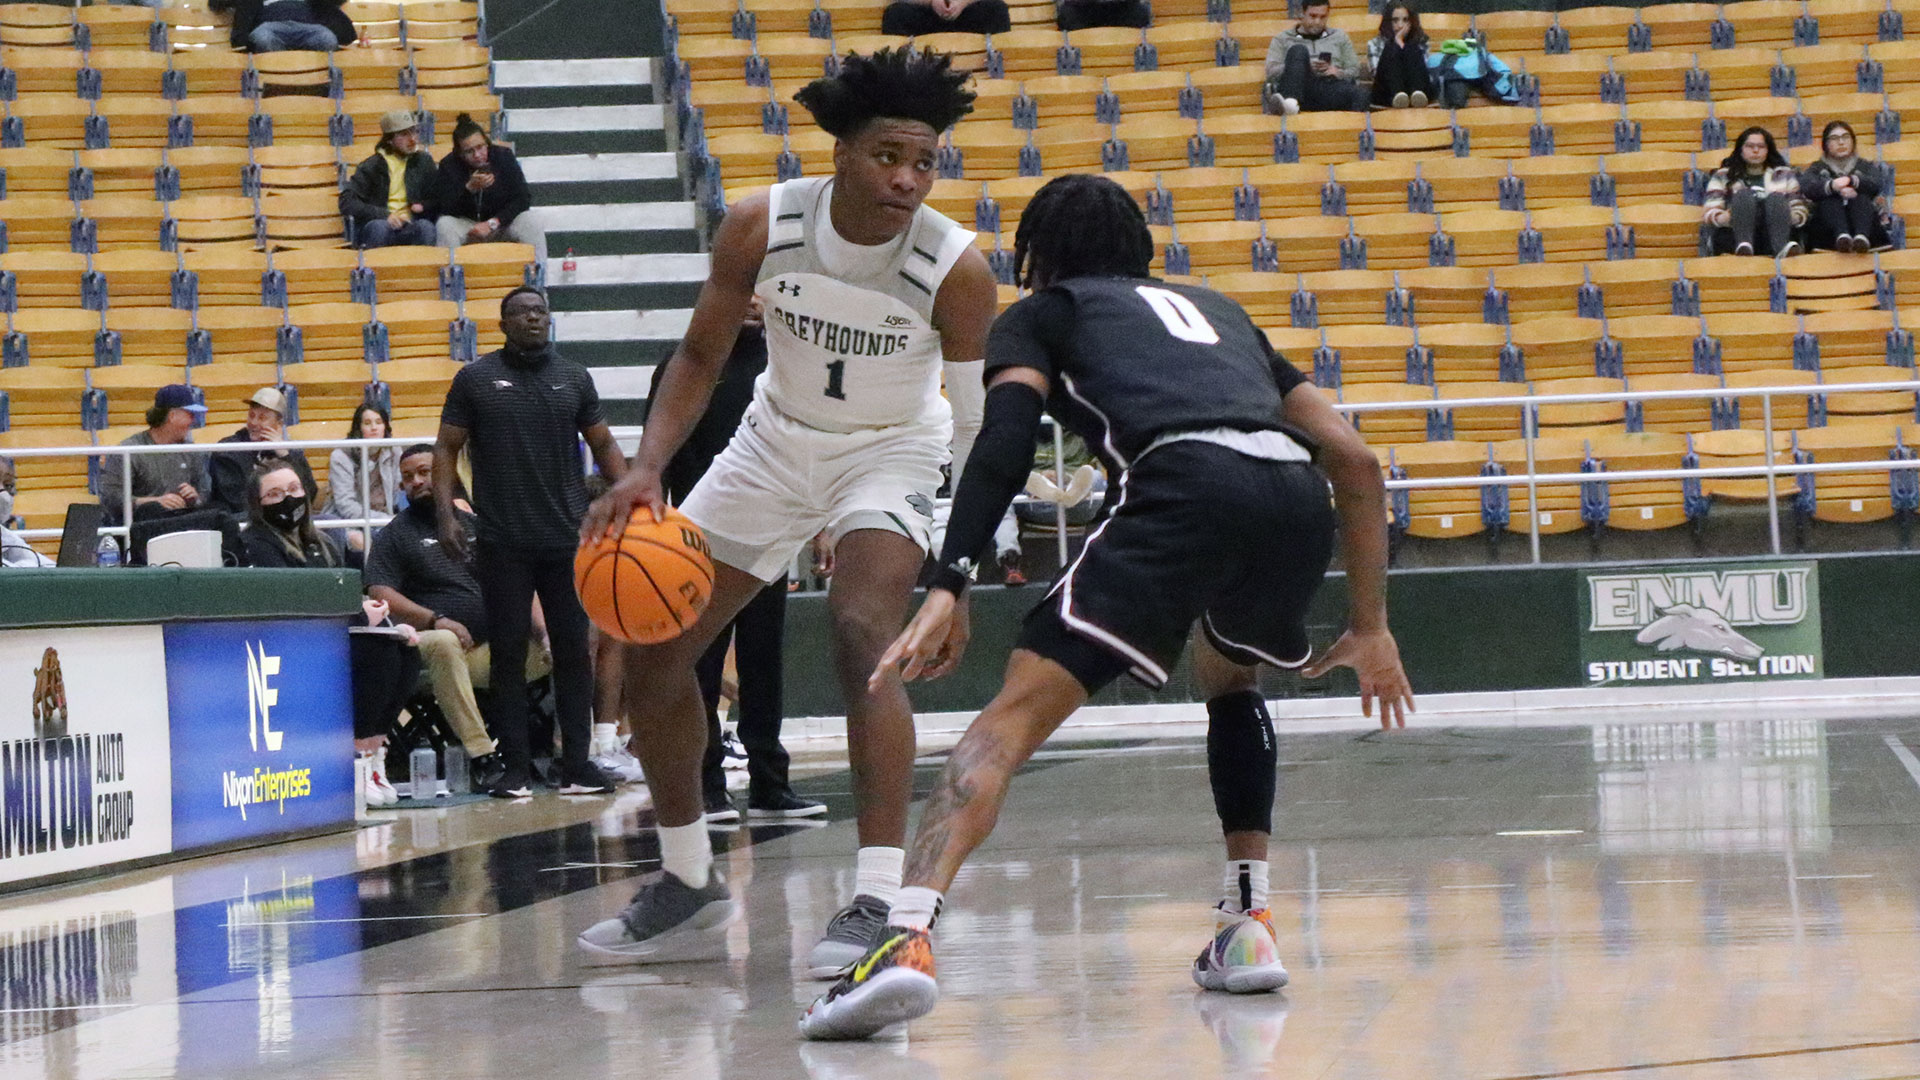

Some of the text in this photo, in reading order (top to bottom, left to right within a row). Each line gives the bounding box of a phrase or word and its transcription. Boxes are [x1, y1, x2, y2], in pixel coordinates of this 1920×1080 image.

[774, 307, 909, 356] GREYHOUNDS
[1134, 285, 1220, 345] 0
[824, 360, 846, 401] 1
[1587, 568, 1811, 631] ENMU
[1588, 658, 1702, 681] STUDENT
[0, 733, 124, 860] MILTON AUTO
[97, 790, 133, 844] GROUP
